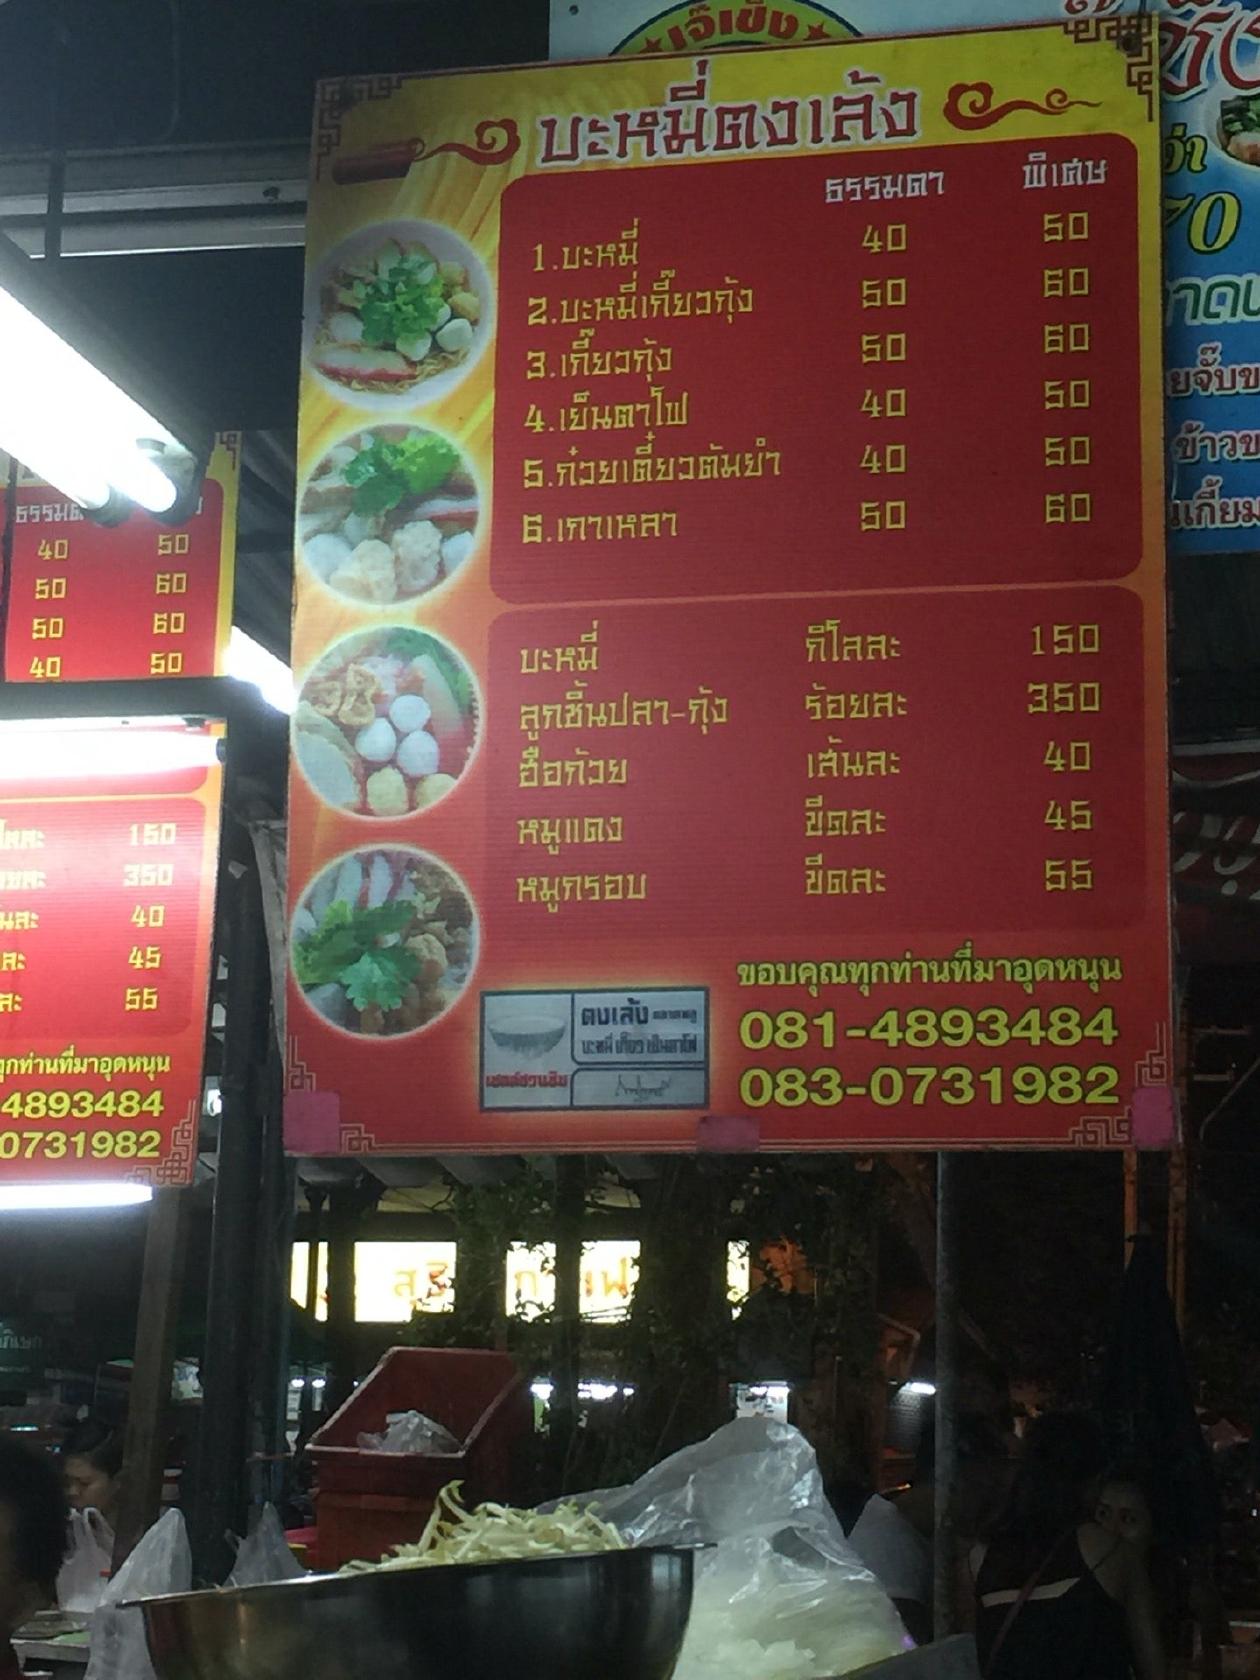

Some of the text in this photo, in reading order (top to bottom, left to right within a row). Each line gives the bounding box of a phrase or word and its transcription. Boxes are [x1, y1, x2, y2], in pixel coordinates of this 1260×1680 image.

[539, 58, 919, 166] บะหมี่ตงเล้ง
[825, 150, 1107, 204] ธรรมดา พิเศษ
[532, 211, 1089, 272] 1.บะหมี่ 40 50
[861, 277, 907, 309] 50
[1043, 267, 1089, 298] 60
[861, 332, 907, 364] 50
[1044, 323, 1090, 354] 60
[524, 379, 1090, 432] 4.เย็นตาโฟ 40 50
[522, 431, 1091, 488] 5.ก๋วยเตี๋ยวต้มยำ 40 50
[521, 493, 1091, 544] 6.เกาเหลา 50 60
[38, 533, 189, 560] 40 50
[35, 572, 188, 600] 50 60
[31, 612, 186, 640] 50 60
[519, 619, 1100, 673] บะหมี่ กิโลละ 150
[29, 652, 183, 679] 40 50
[519, 679, 1100, 741] ลูกชิ้นปลา-กุ้ง ร้อยละ 350
[807, 735, 901, 779] เส้นละ
[1043, 740, 1091, 772] 40
[129, 822, 177, 846] 150
[517, 794, 1092, 855] หมูแดง ขีดละ 45
[123, 863, 174, 888] 350
[516, 852, 1093, 913] หมูกรอบ ขีดละ 55
[130, 904, 165, 928] 40
[127, 945, 161, 969] 45
[736, 940, 1123, 998] ขอบคุณทุกท่านที่มาอุดหนุน
[124, 987, 158, 1011] 55
[740, 1007, 1119, 1049] 081-4893484
[1, 1089, 165, 1119] 4893484
[740, 1065, 1119, 1107] 083-0731982
[0, 1130, 162, 1160] 0731982
